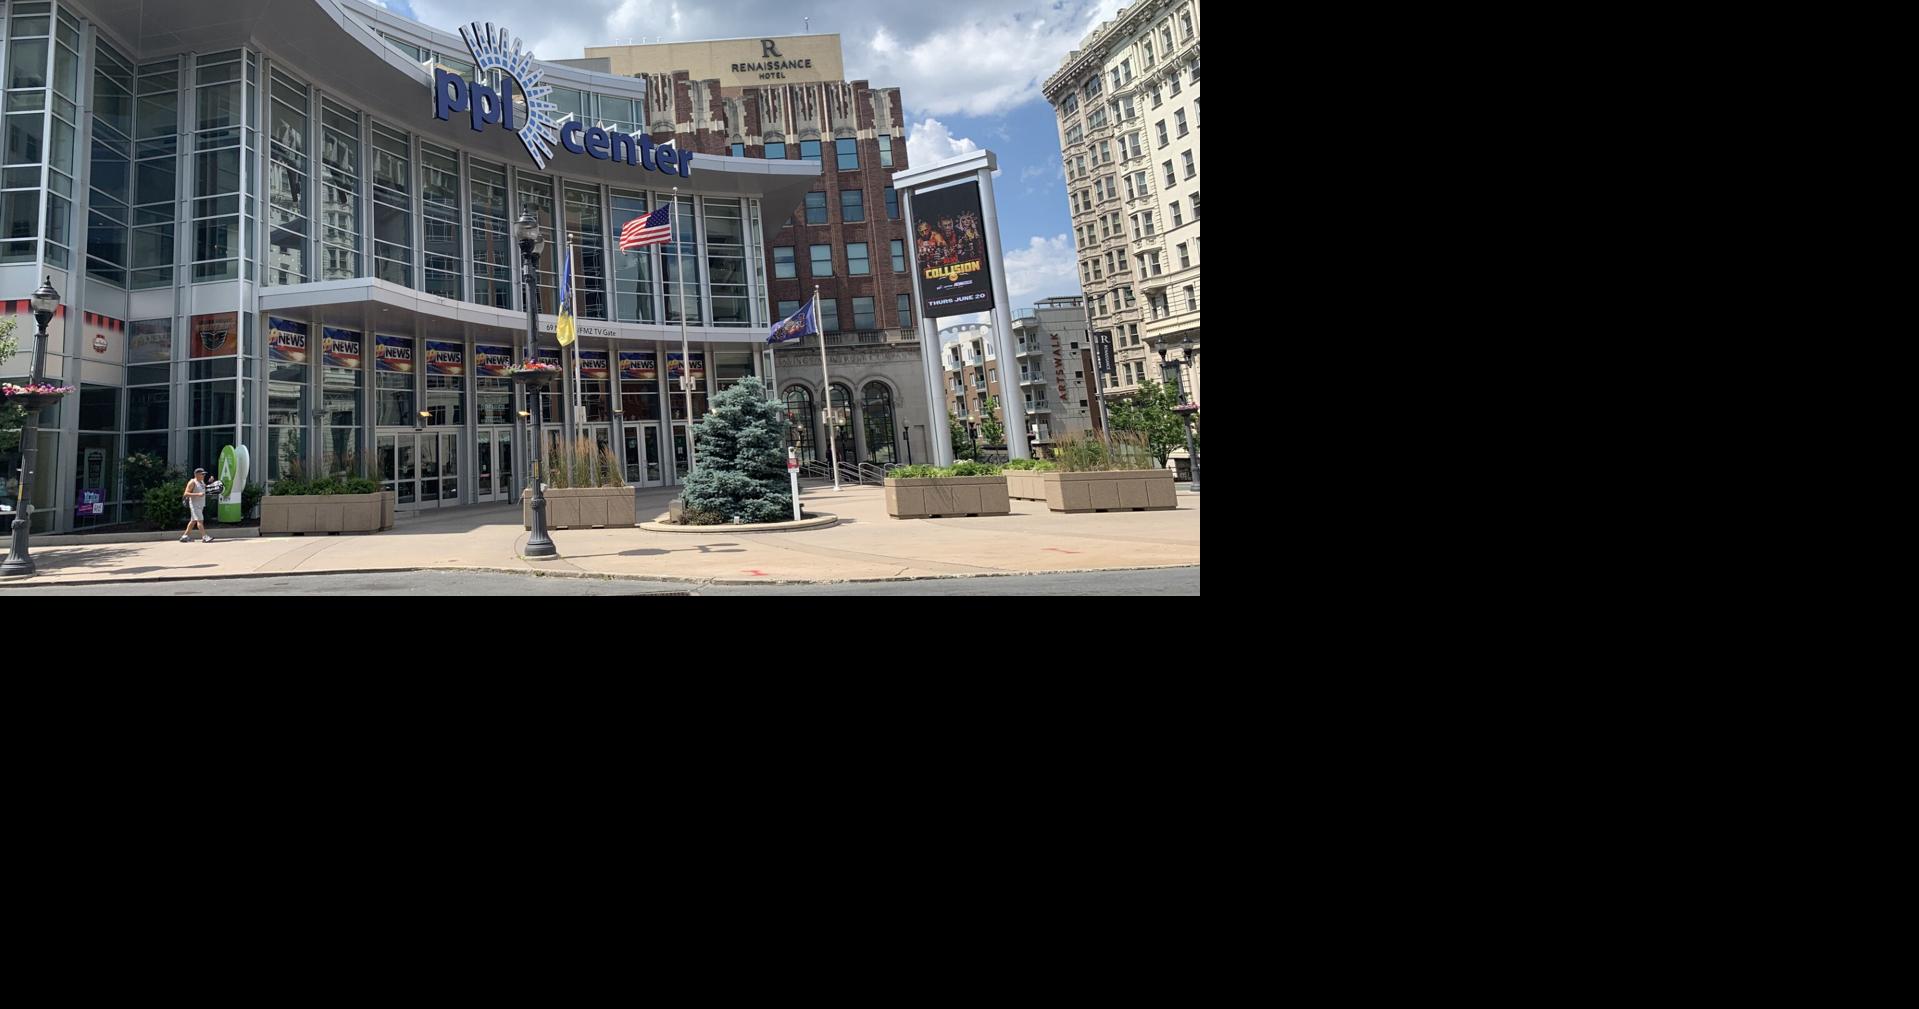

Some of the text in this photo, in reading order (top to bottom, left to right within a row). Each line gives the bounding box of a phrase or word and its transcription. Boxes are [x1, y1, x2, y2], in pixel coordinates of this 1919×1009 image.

[760, 39, 783, 58] R
[731, 59, 812, 73] RENAISSANCE
[759, 72, 786, 80] HOTEL
[435, 67, 693, 178] ppl center
[925, 260, 981, 279] COLLISION
[928, 298, 953, 306] THURS
[954, 294, 974, 302] JUNE
[594, 328, 603, 336] TV
[603, 329, 617, 337] Gate
[278, 332, 305, 348] NEWS
[1100, 335, 1110, 344] R
[332, 341, 359, 355] NEWS
[385, 347, 411, 359] NEWS
[436, 352, 461, 363] NEWS
[582, 359, 606, 369] NEWS
[630, 359, 655, 369] NEWS
[678, 359, 703, 369] NWS
[1050, 333, 1067, 401] ARTSWALK
